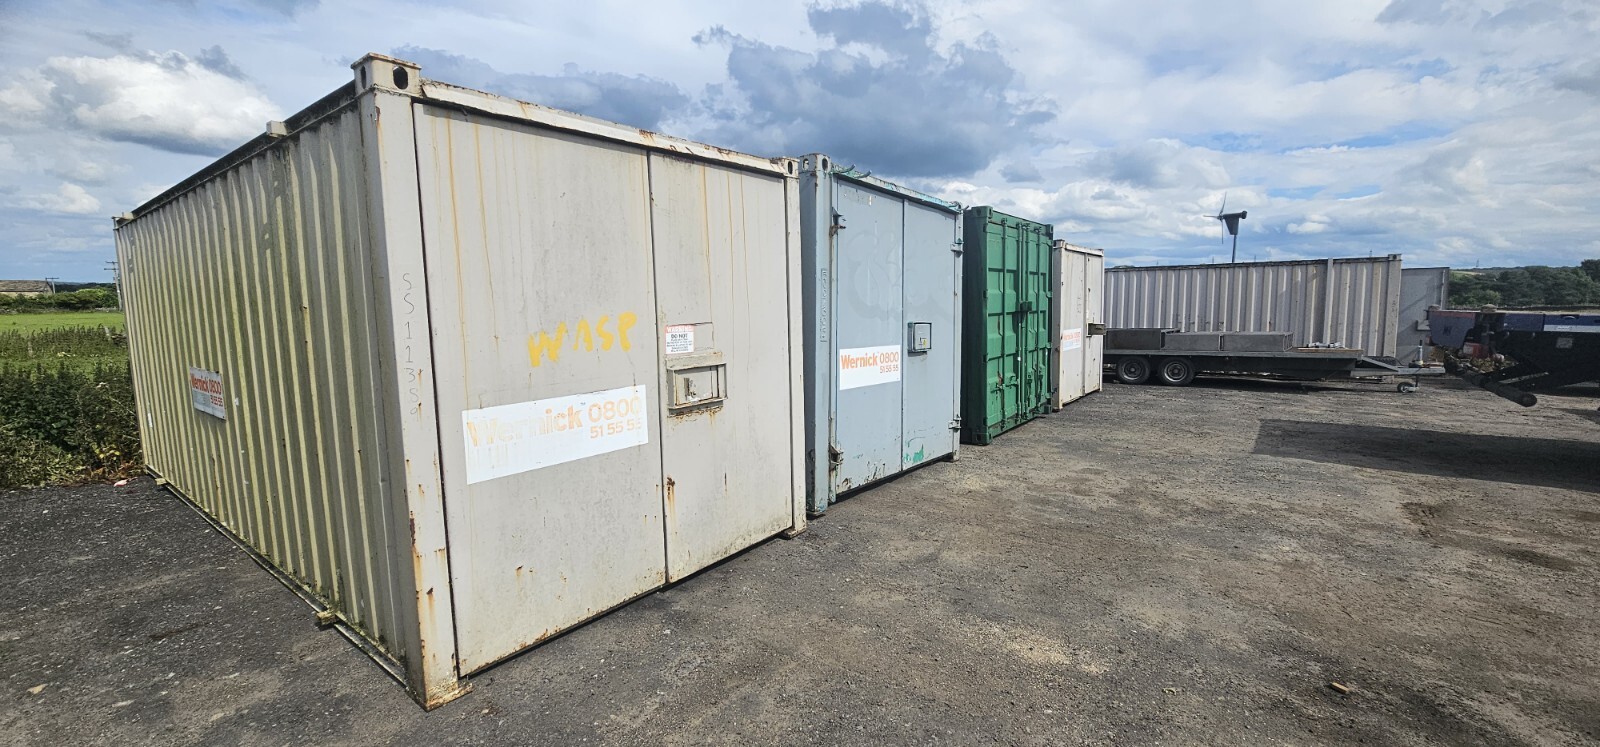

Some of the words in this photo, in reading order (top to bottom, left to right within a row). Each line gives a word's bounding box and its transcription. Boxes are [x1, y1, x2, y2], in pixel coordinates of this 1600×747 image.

[527, 311, 638, 368] WASP
[841, 351, 878, 370] Wernick
[879, 351, 899, 364] 0800
[590, 425, 604, 439] 51
[607, 422, 624, 435] 55
